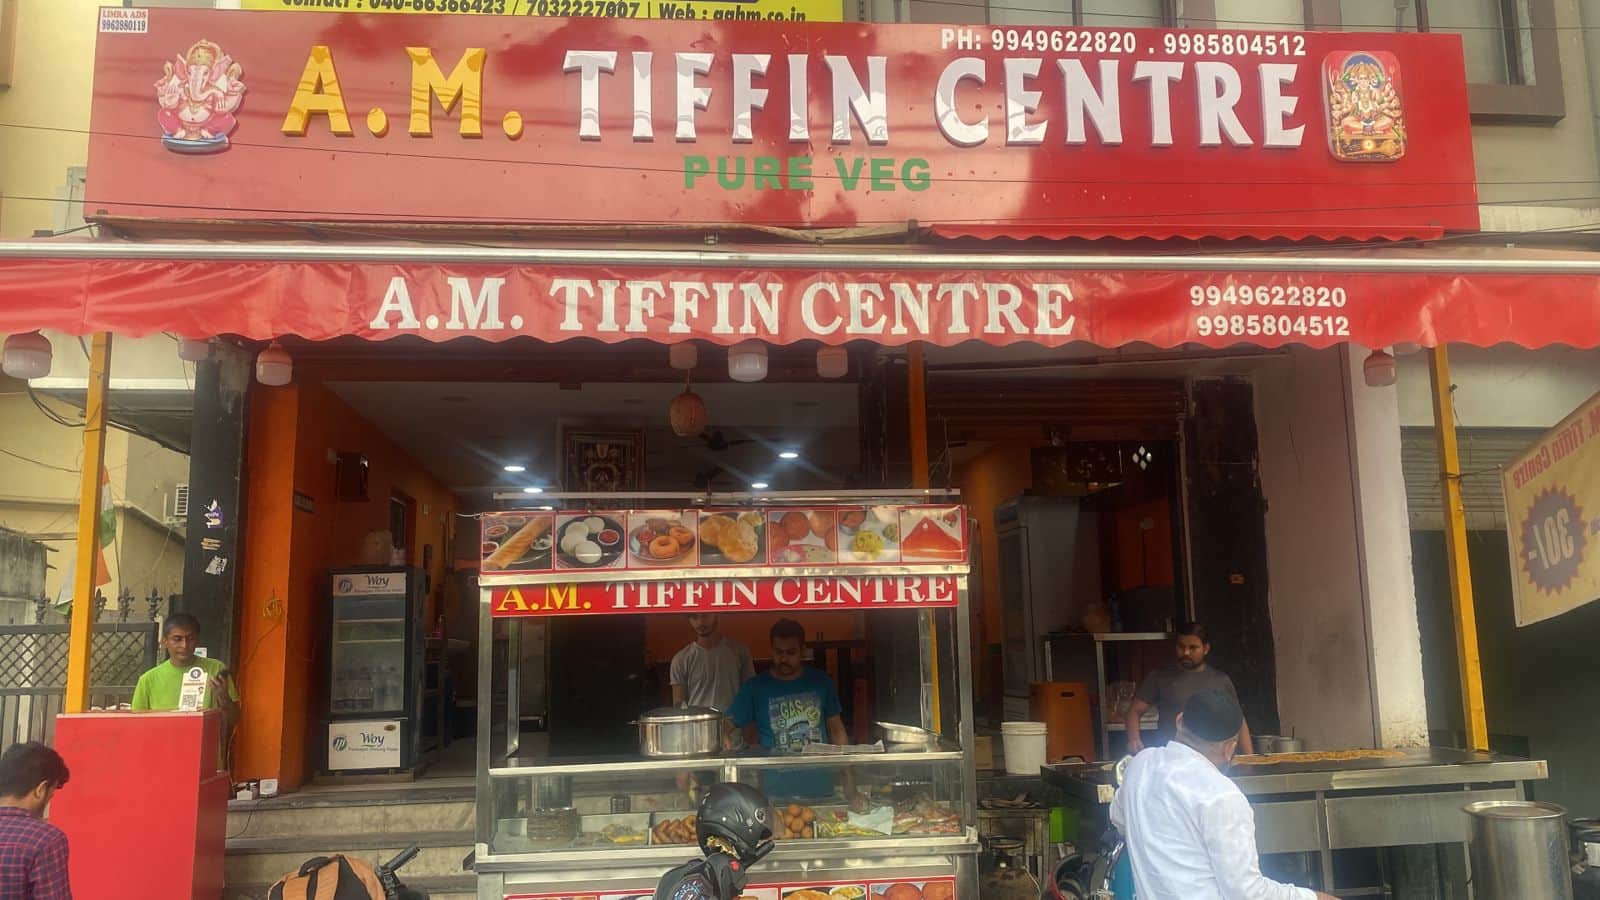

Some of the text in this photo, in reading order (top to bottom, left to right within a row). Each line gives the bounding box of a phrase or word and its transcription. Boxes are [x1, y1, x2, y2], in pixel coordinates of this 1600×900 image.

[659, 3, 695, 20] Web
[941, 28, 982, 50] PH:
[991, 29, 1136, 53] 9949622820
[1164, 33, 1306, 56] 9985804512
[280, 45, 1306, 148] A.M. TIFFIN CENTRE
[683, 155, 932, 192] PURE VEG
[369, 276, 1076, 336] A.M. TIFFIN CENTRE
[1190, 284, 1347, 308] 9949622820
[1197, 315, 1350, 337] 9985804512
[496, 573, 954, 611] A.M. TIFFIN CENTRE
